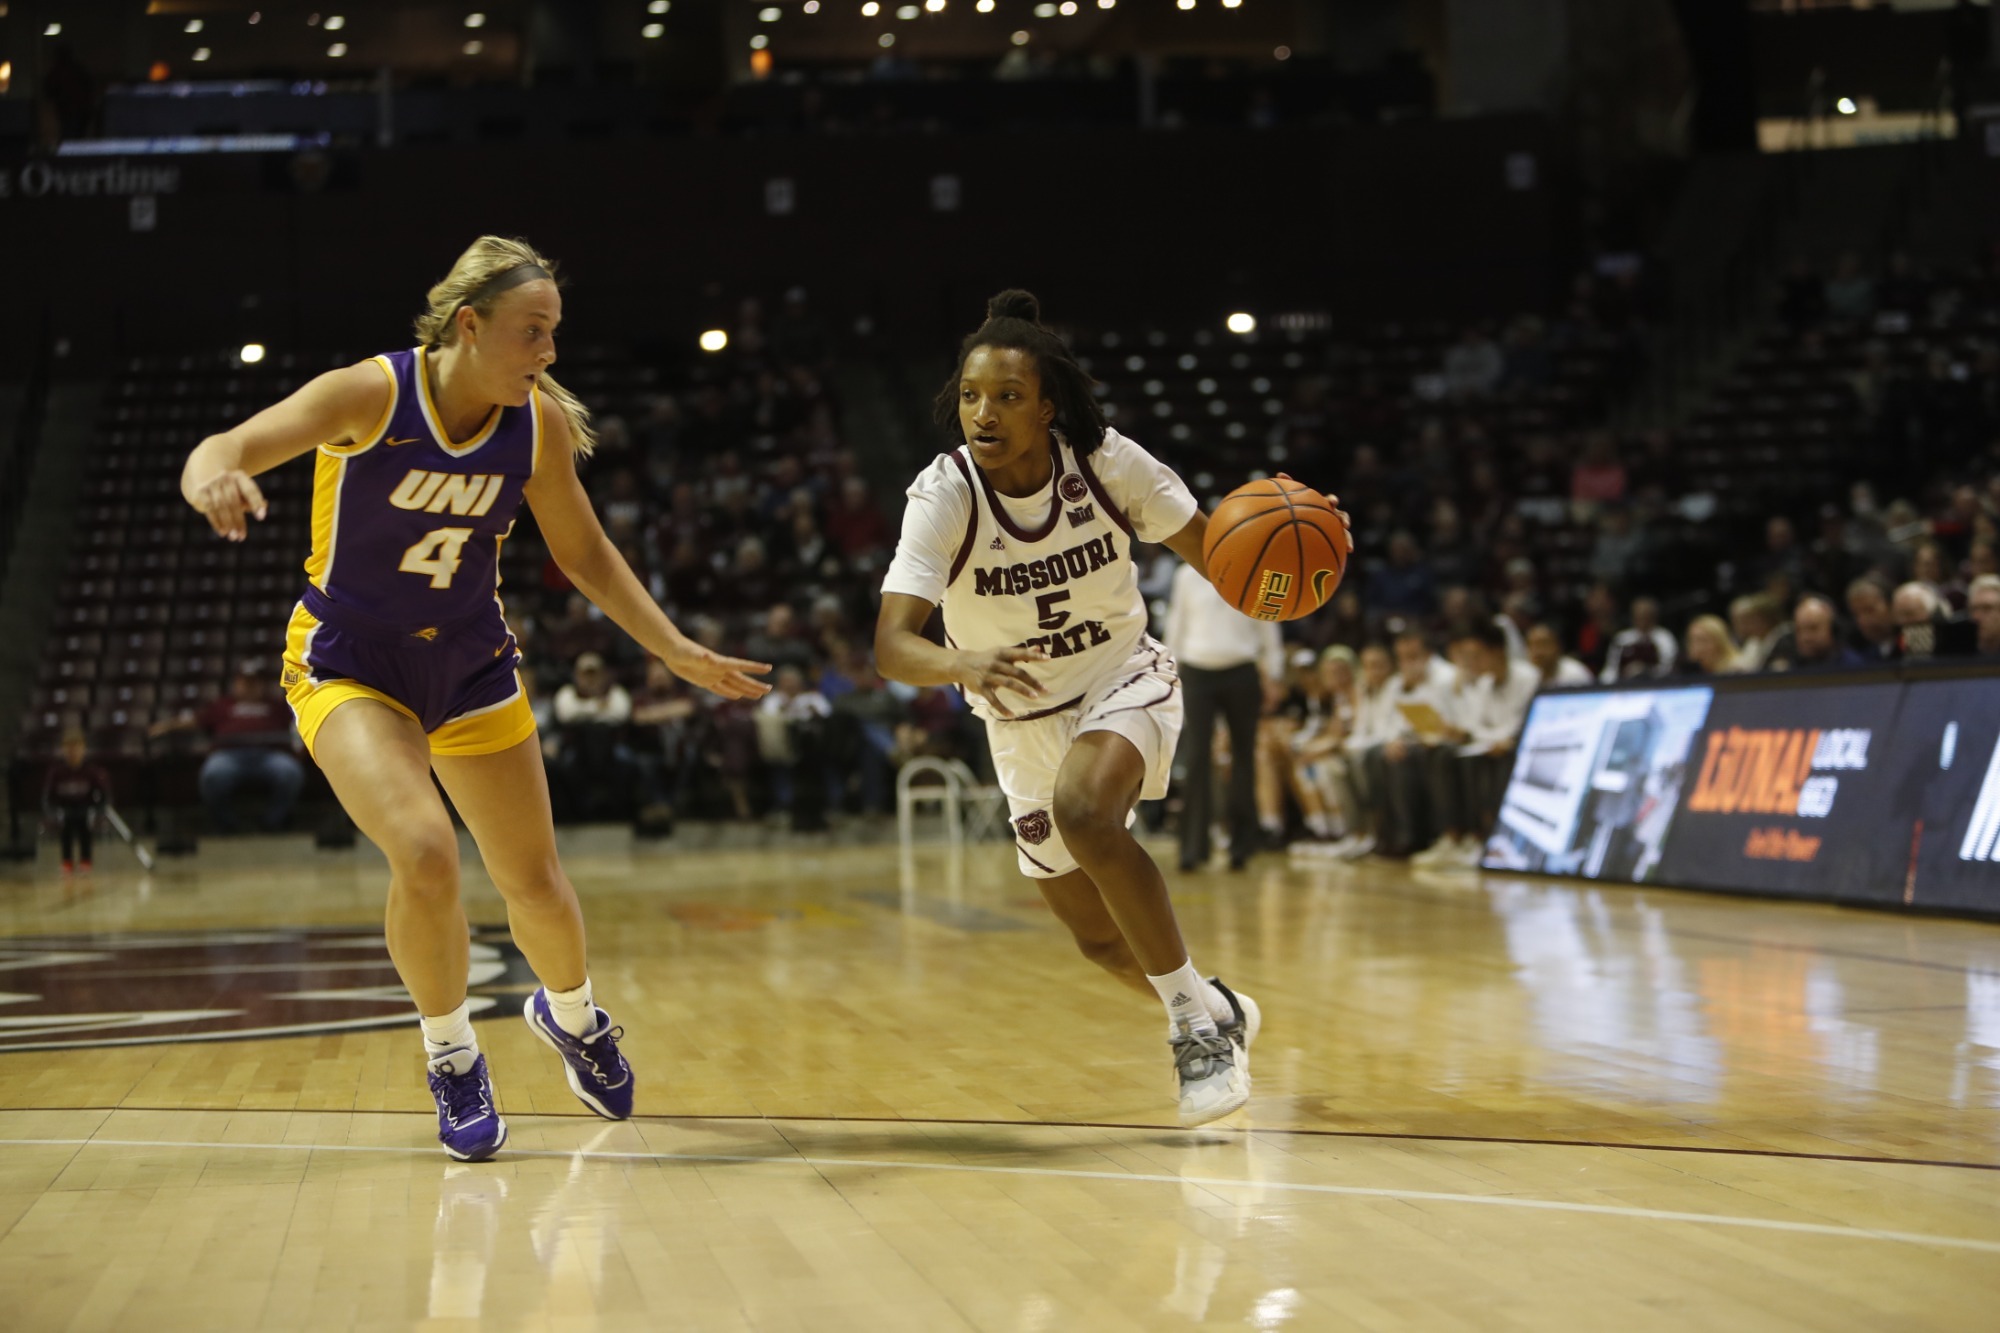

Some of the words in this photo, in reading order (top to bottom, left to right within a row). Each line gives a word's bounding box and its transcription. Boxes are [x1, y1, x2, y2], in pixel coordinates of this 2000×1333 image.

[20, 160, 178, 197] Overtime
[389, 469, 505, 517] UNI
[398, 527, 474, 589] 4
[974, 531, 1119, 597] MISSOURI
[1035, 588, 1072, 630] 5
[1812, 728, 1872, 770] LOCAL
